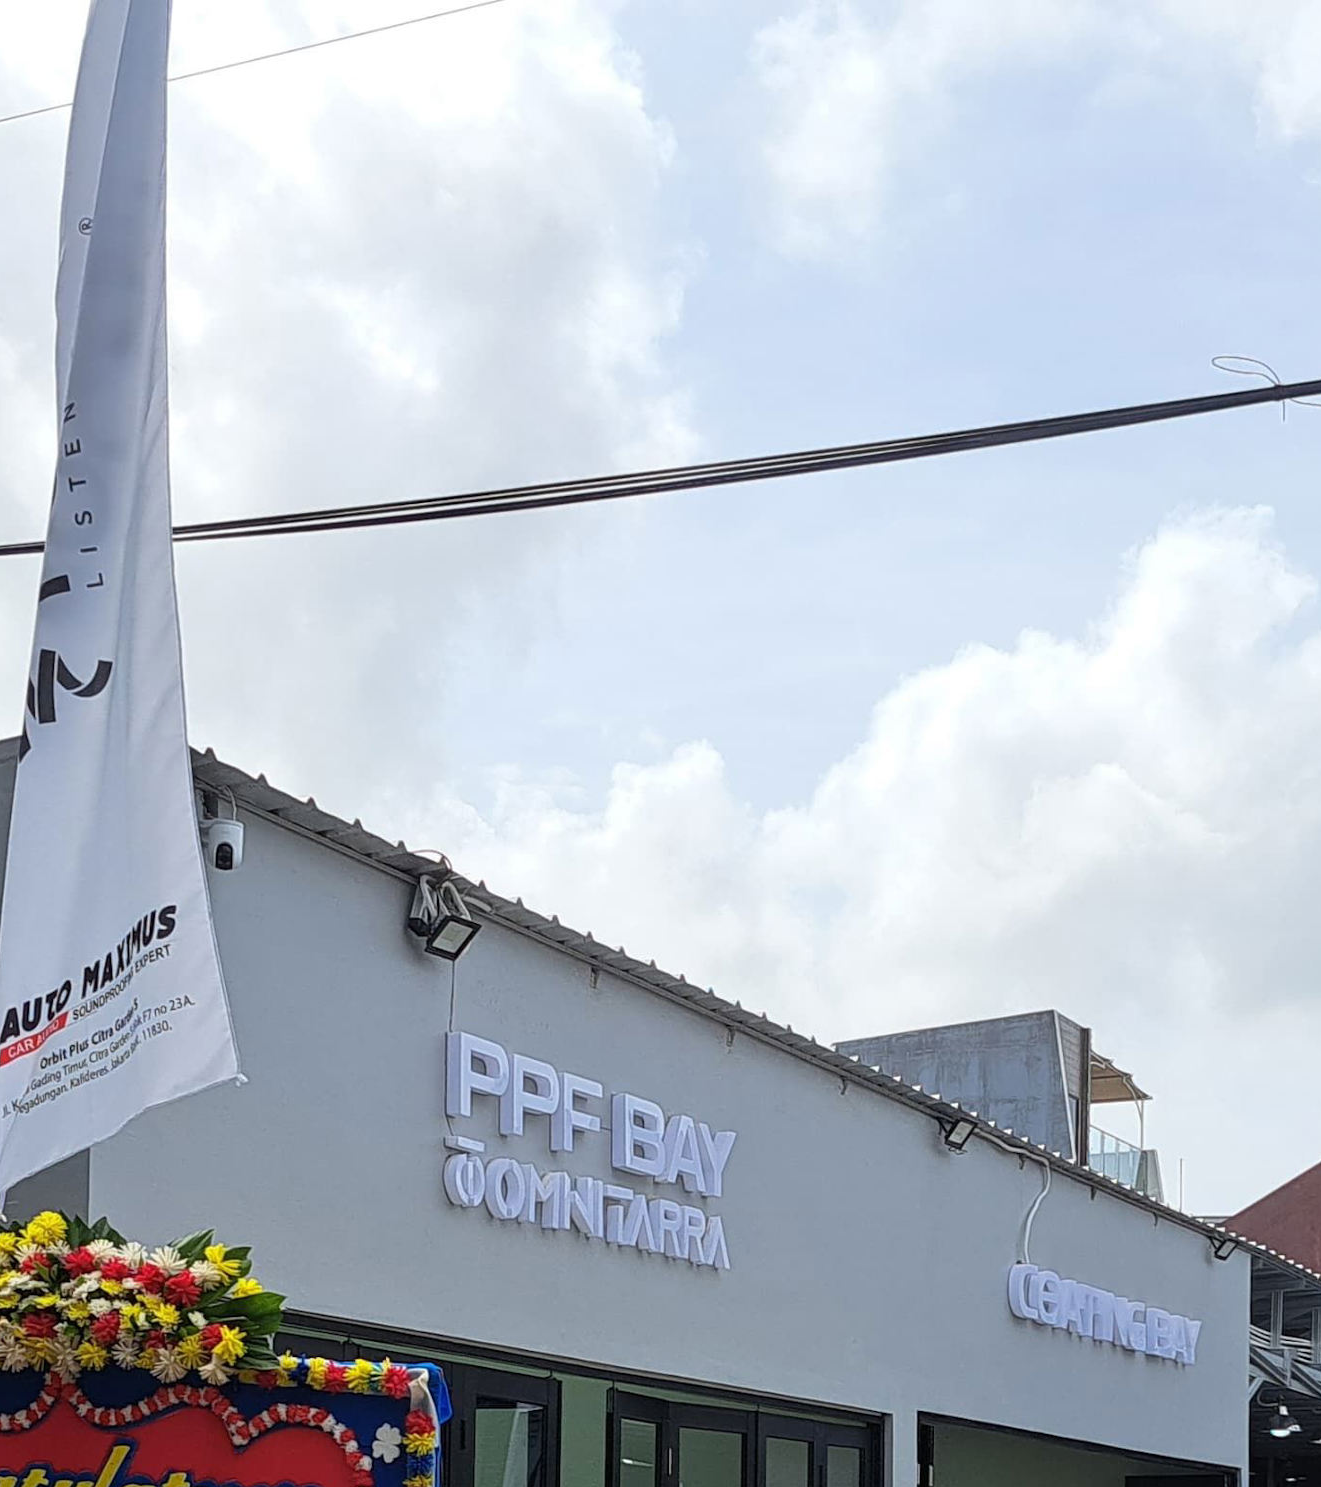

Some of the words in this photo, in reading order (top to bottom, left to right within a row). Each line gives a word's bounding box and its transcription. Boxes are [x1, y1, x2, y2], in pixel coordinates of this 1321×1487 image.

[0, 980, 72, 1045] AUTO
[81, 905, 177, 999] MAXIMUS
[8, 1038, 35, 1058] CAR
[135, 944, 171, 973] EXPERT
[40, 1049, 68, 1069] Orbit
[69, 1037, 89, 1057] Plus
[92, 1027, 113, 1045] Citra
[89, 1048, 109, 1063] Citra
[445, 1031, 604, 1152] PPF
[611, 1093, 737, 1197] BAY
